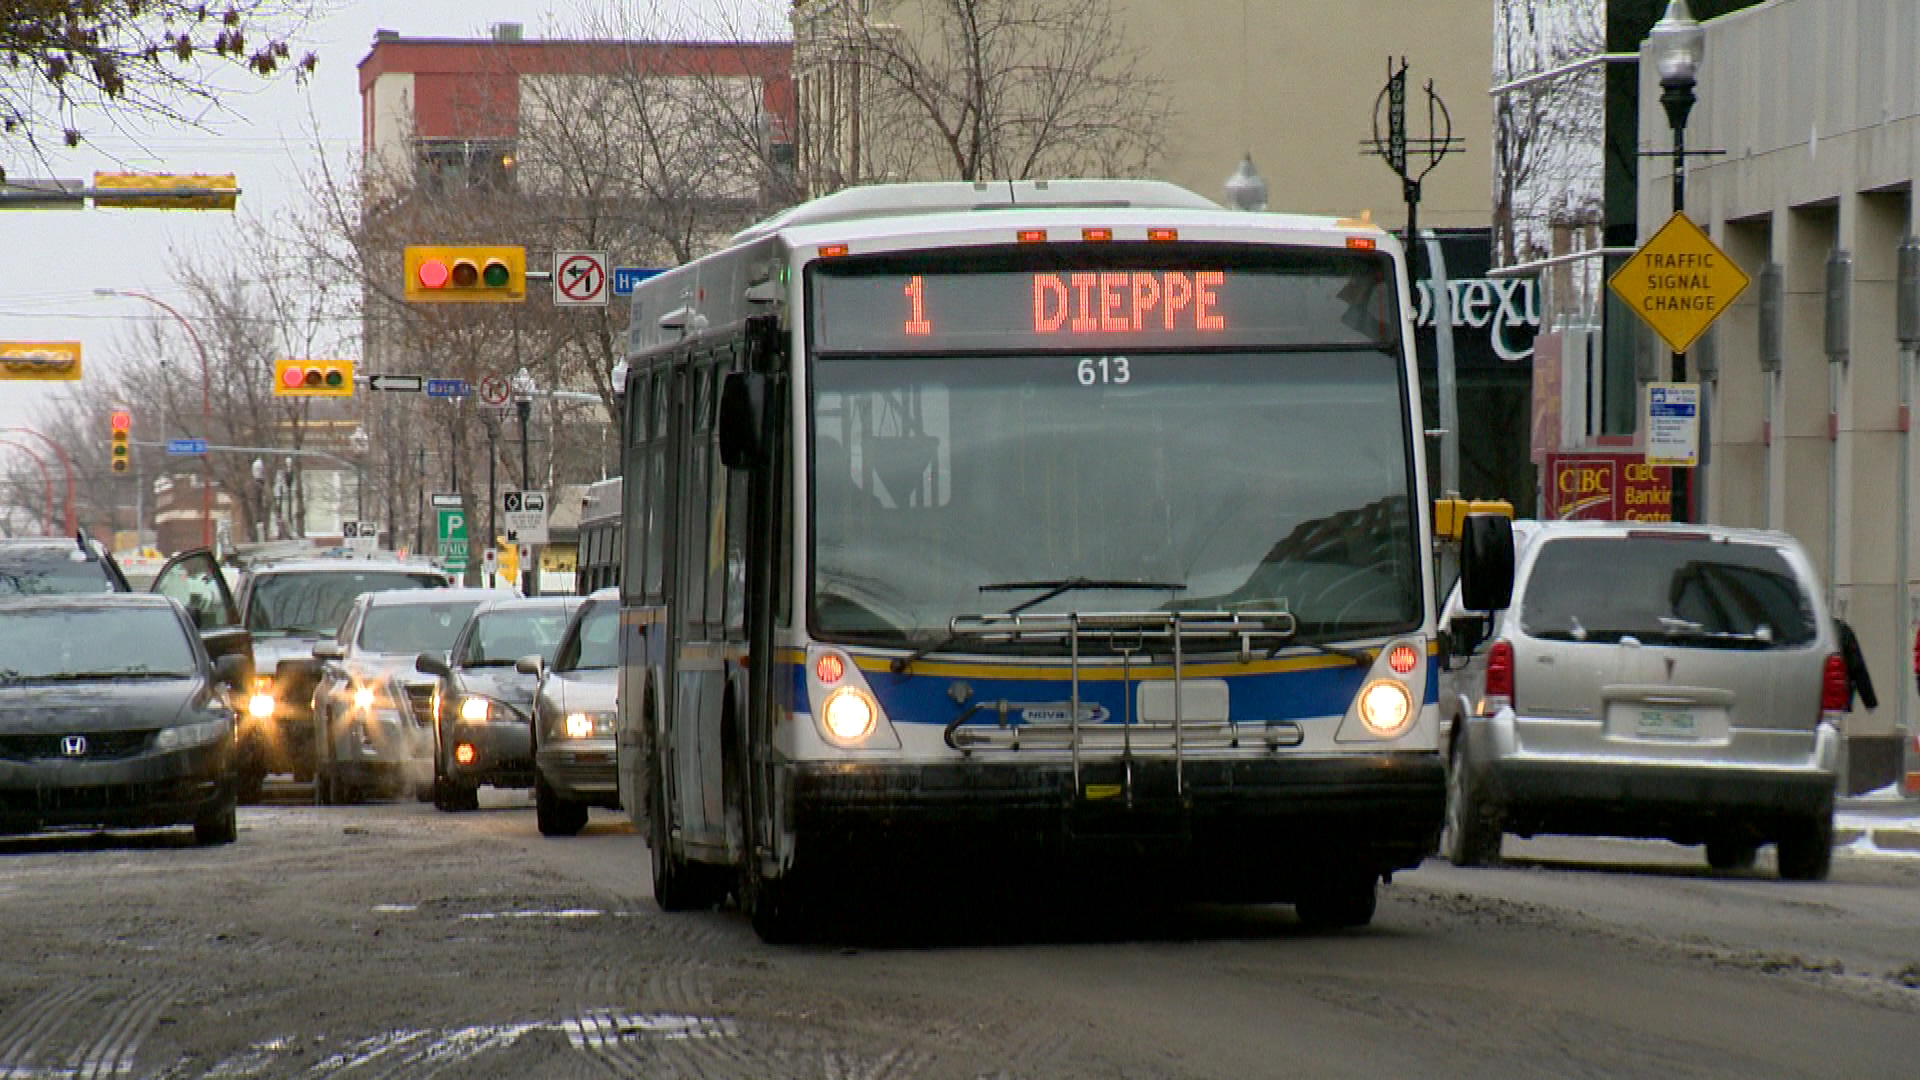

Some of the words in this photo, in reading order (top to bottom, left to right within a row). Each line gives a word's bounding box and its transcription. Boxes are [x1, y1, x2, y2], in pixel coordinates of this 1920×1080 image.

[1644, 253, 1713, 268] TRAFFIC
[1648, 274, 1711, 289] SIGNAL
[904, 275, 932, 335] 1
[1034, 271, 1225, 332] DIEPPE
[1643, 296, 1715, 311] CHANGE
[1077, 356, 1131, 385] 613
[1625, 463, 1660, 480] CIBC
[448, 515, 463, 535] P
